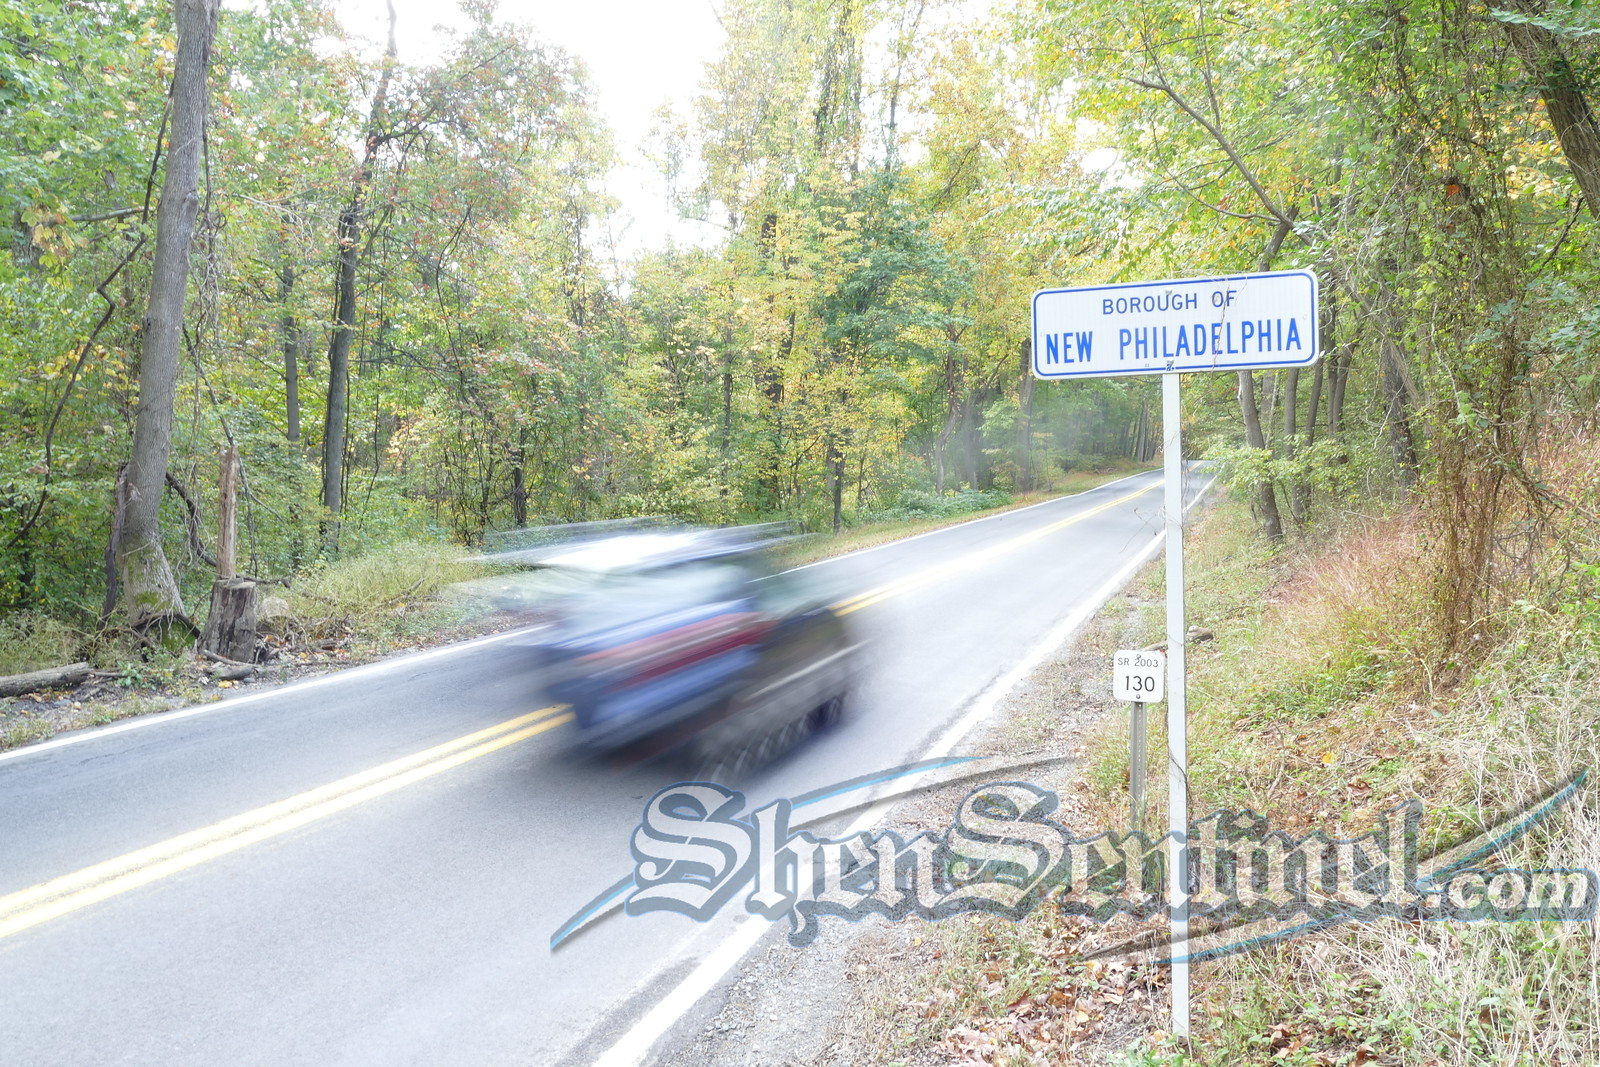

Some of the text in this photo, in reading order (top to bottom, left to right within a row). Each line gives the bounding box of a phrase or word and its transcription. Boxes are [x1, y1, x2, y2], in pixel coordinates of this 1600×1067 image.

[1102, 289, 1237, 315] BOROUGH OF
[1046, 317, 1302, 365] NEW PHILADELPHIA
[1117, 657, 1159, 668] SR 2003
[1125, 675, 1155, 692] 130
